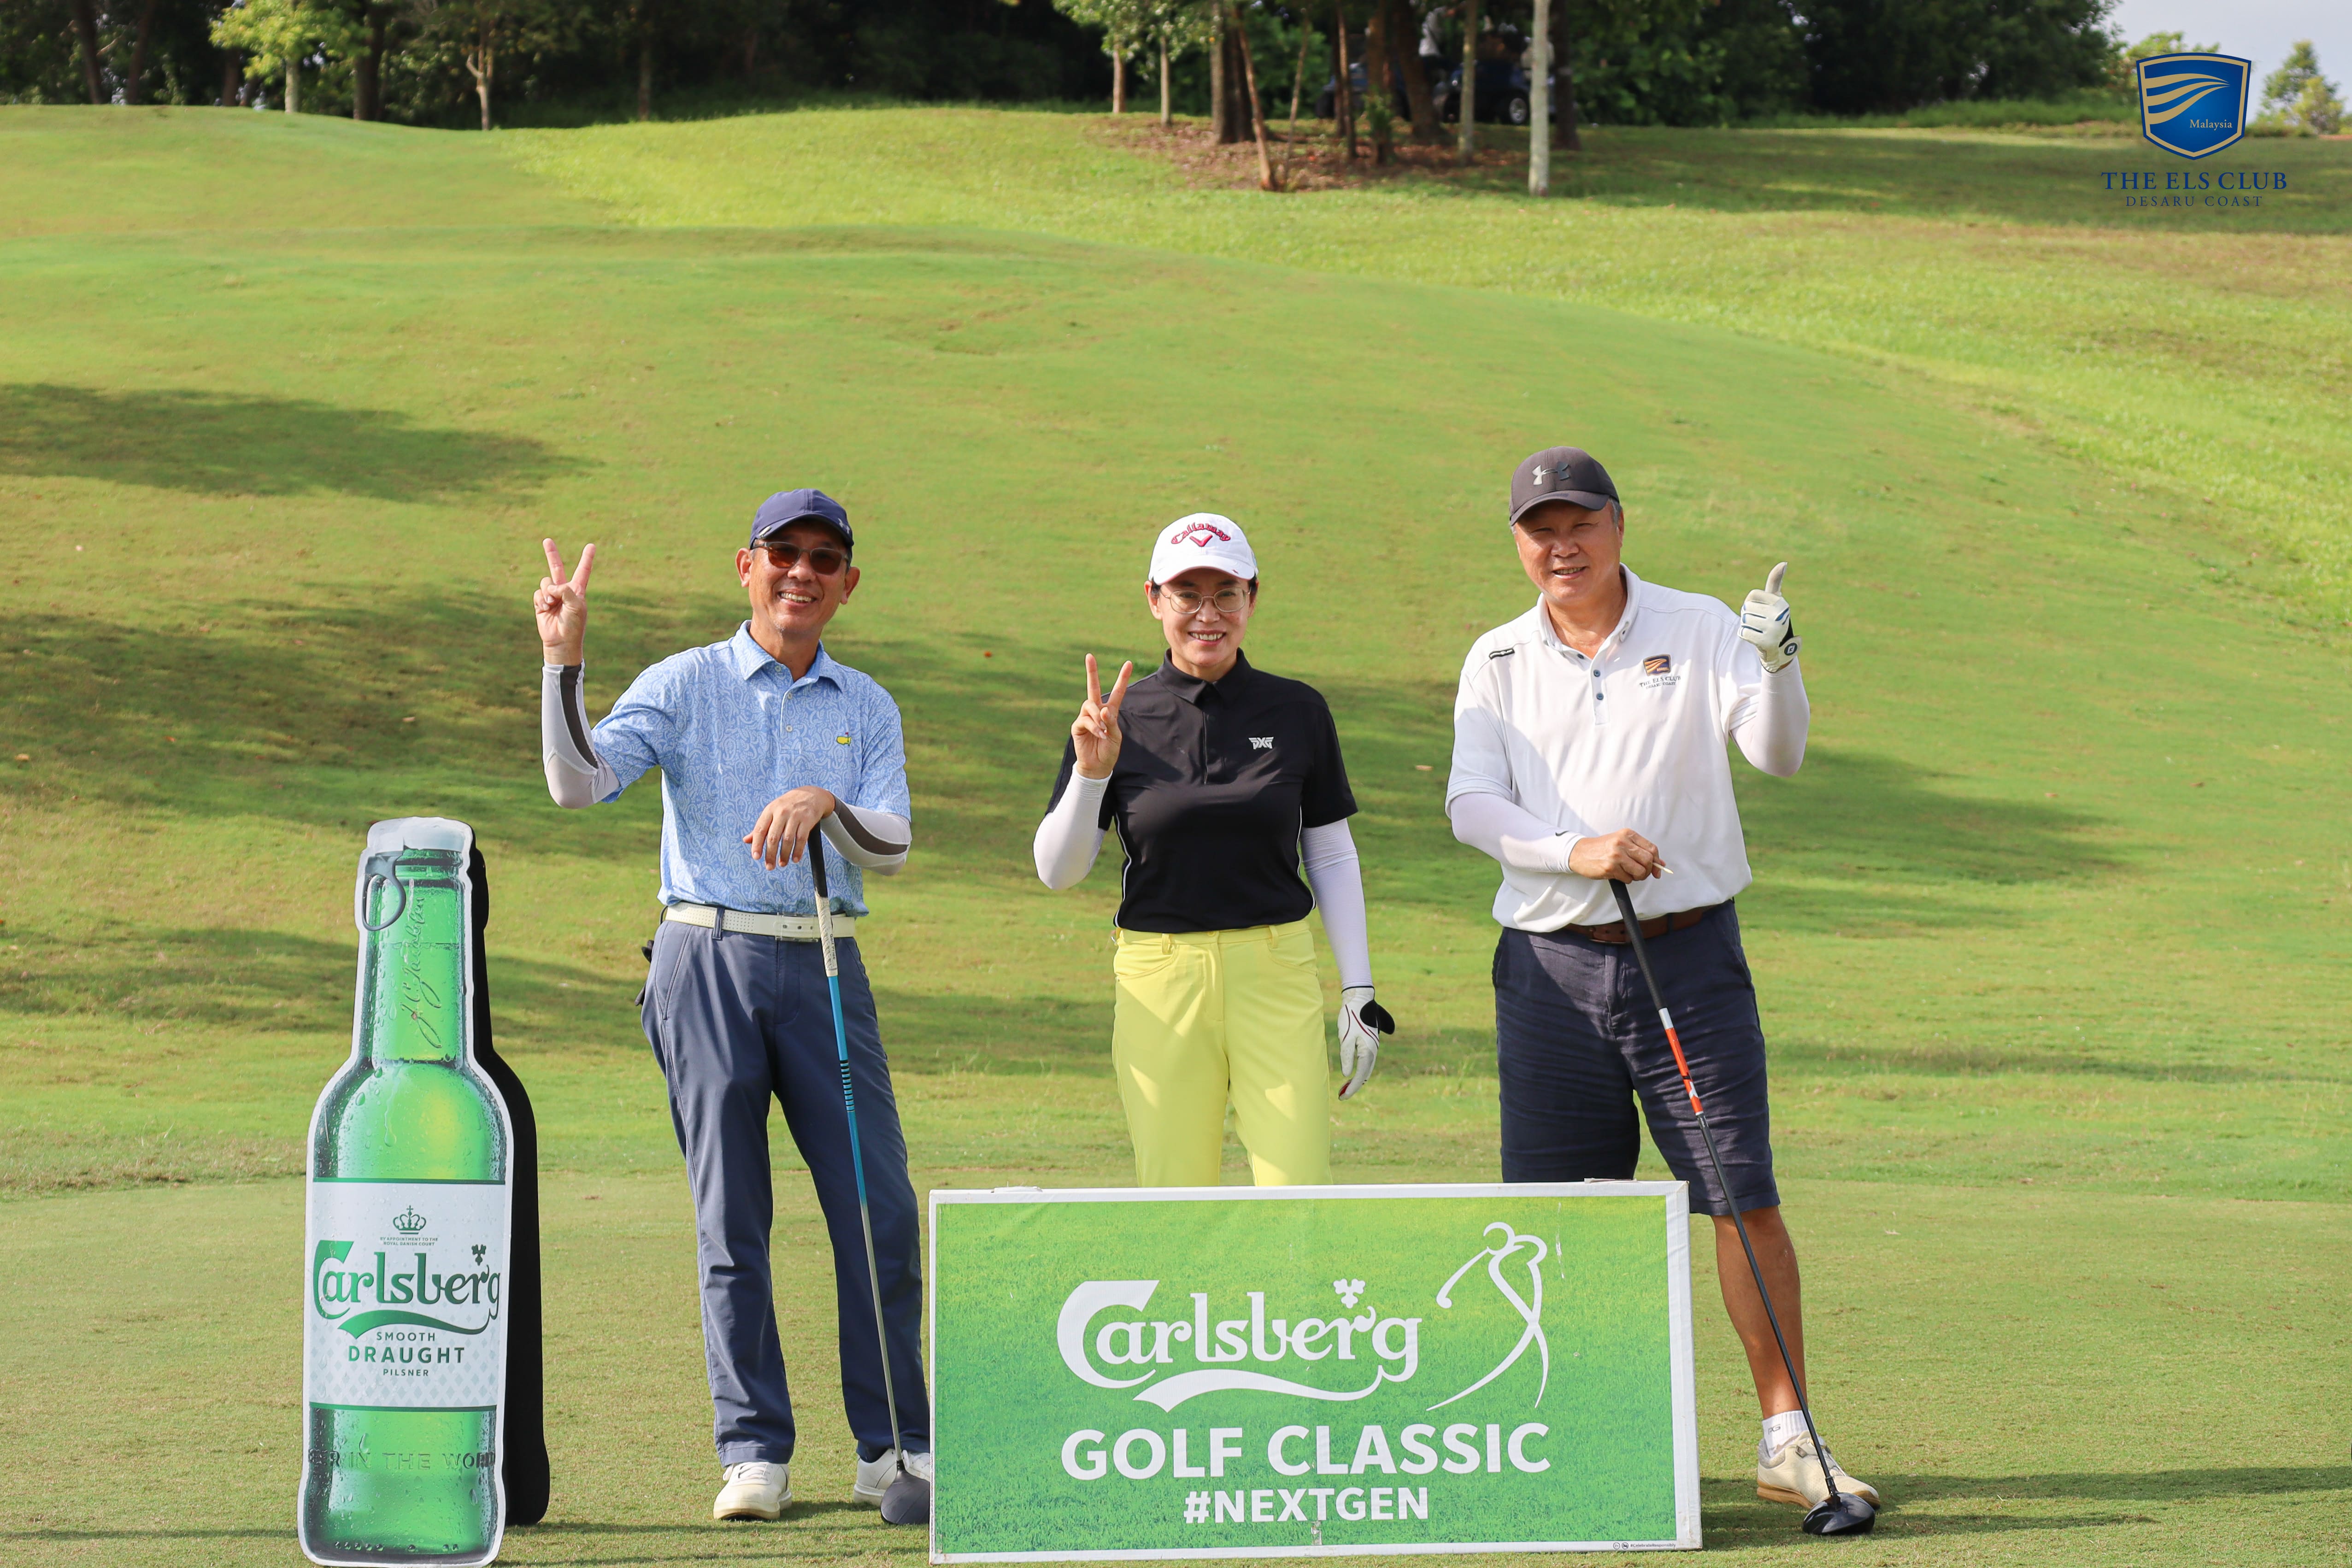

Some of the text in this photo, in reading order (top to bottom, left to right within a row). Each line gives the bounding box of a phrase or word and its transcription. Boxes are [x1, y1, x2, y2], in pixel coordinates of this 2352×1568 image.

[1171, 523, 1231, 544] Callaway
[1248, 736, 1274, 750] PXG
[313, 1240, 501, 1321] Carlsberg
[376, 1332, 435, 1341] SMOOTH
[1057, 1279, 1423, 1389] Carlsberg
[348, 1345, 465, 1363] DRAUGHT
[382, 1453, 431, 1470] THE
[1061, 1422, 1552, 1481] GOLF CLASSIC
[1183, 1487, 1429, 1524] #NEXTGEN
